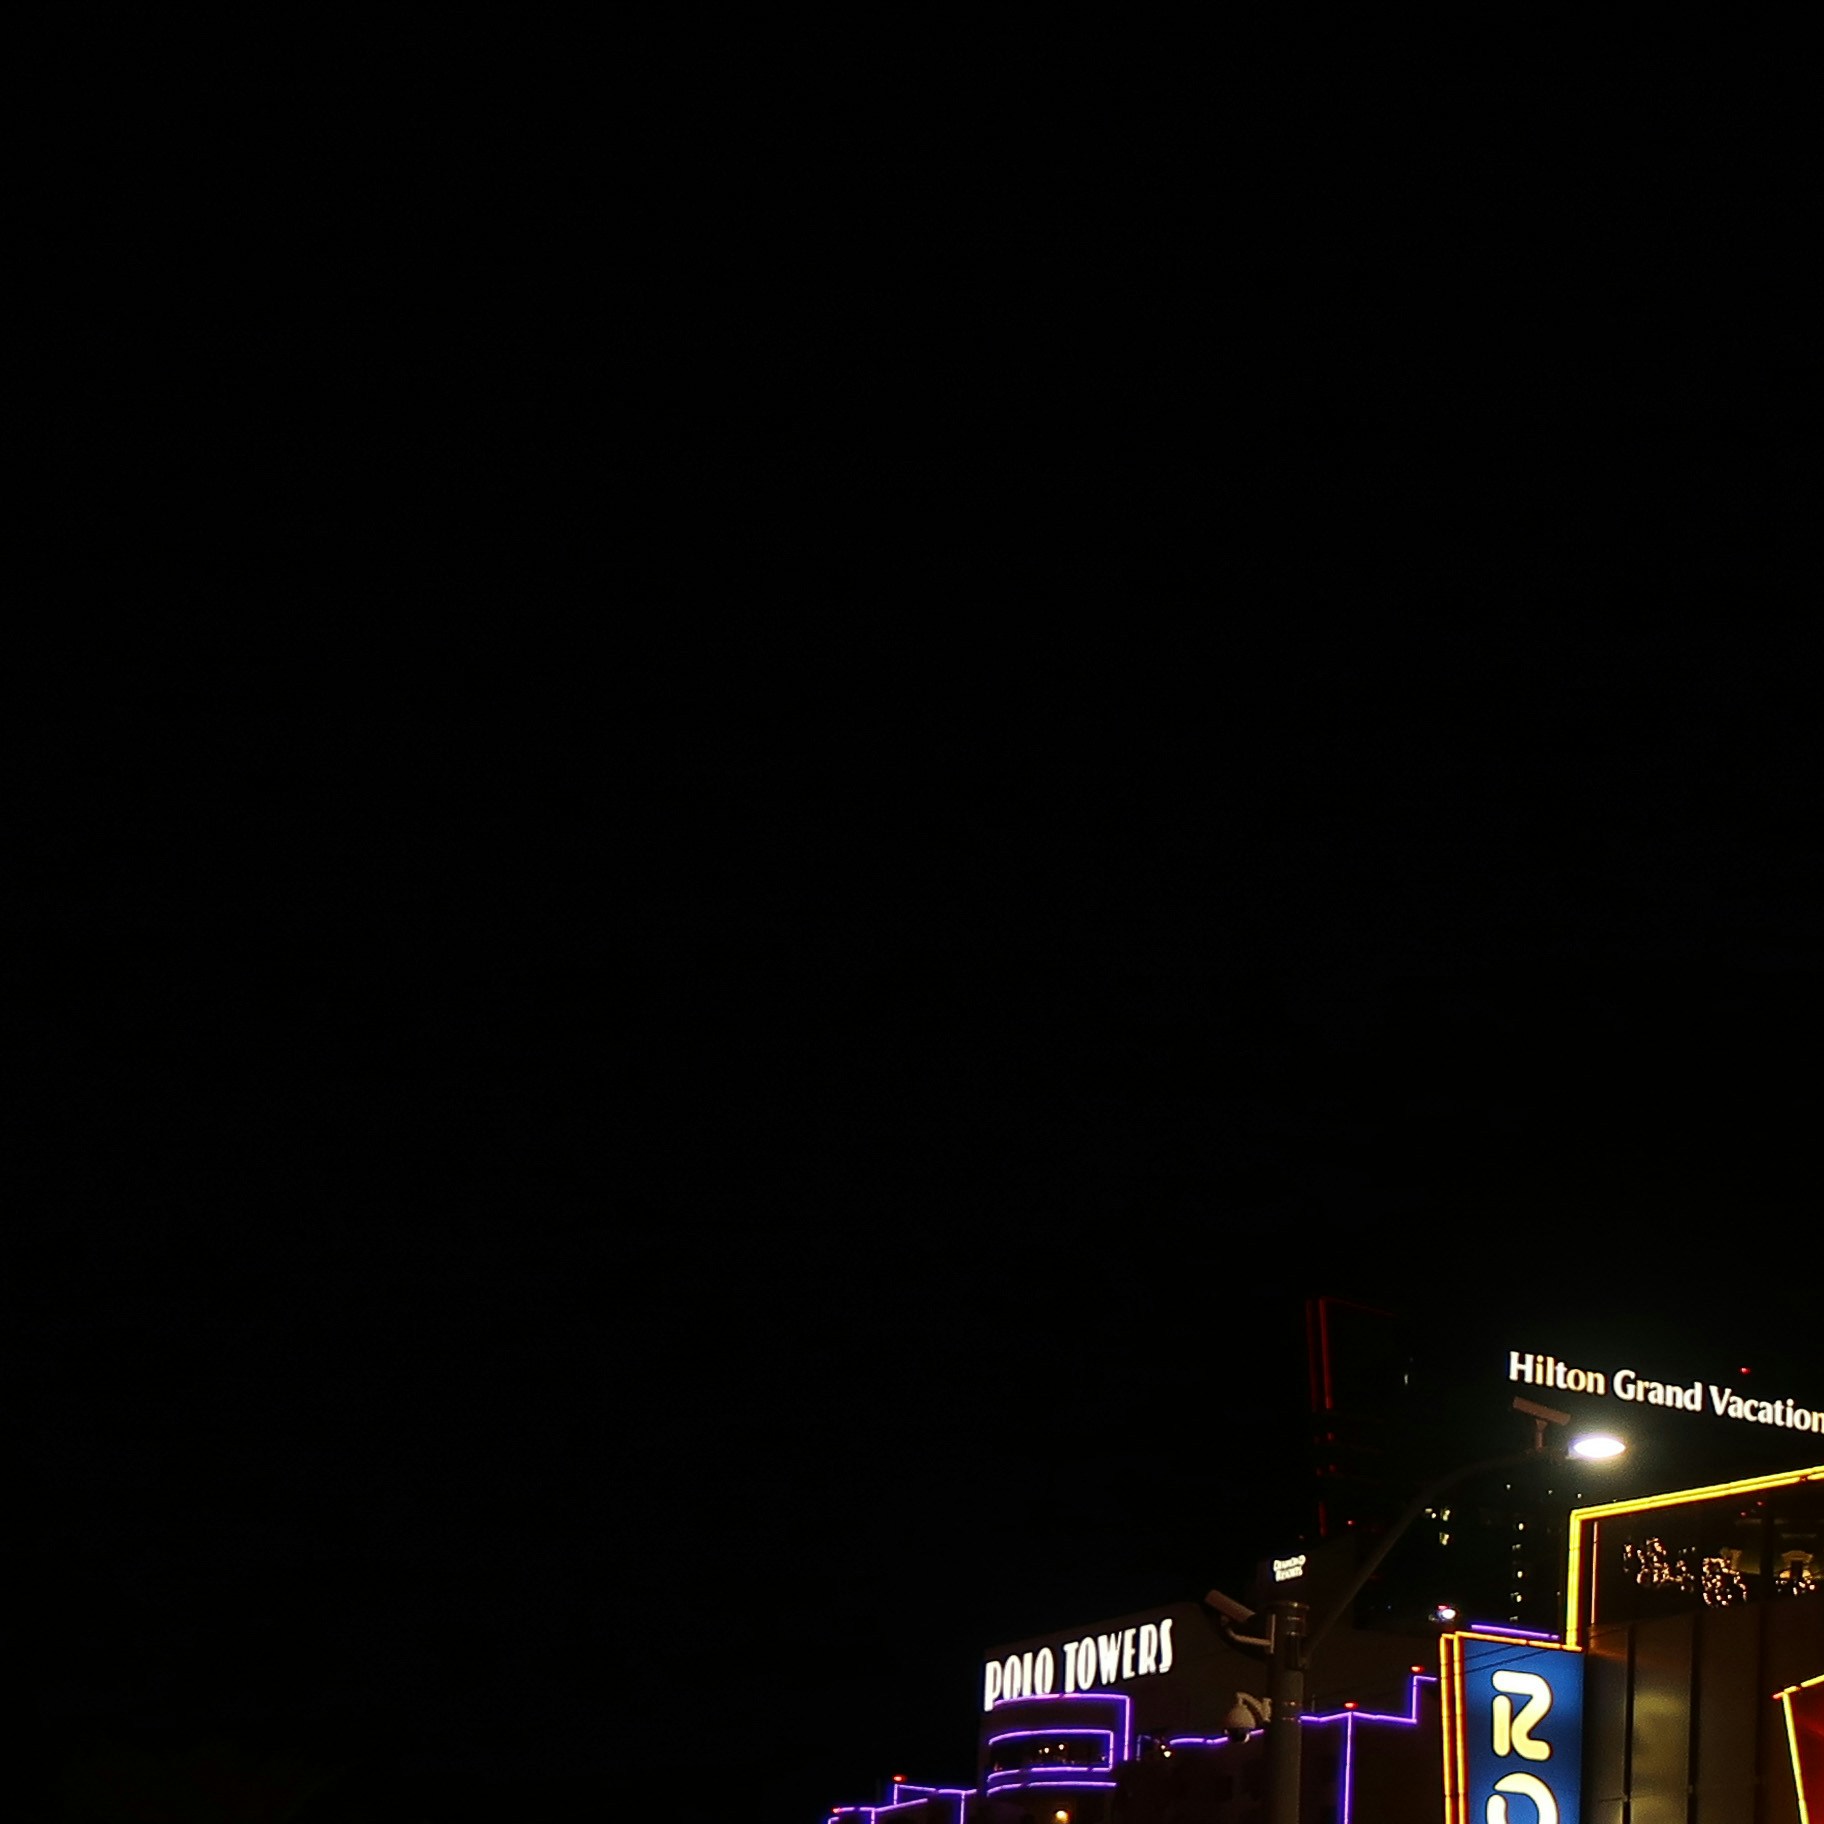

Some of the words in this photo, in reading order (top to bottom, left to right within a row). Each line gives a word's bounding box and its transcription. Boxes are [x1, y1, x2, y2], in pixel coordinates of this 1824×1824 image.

[1508, 1350, 1606, 1395] Hilton
[1613, 1369, 1703, 1412] Grand
[984, 1646, 1054, 1711] POLO
[1063, 1618, 1173, 1692] TOWERS
